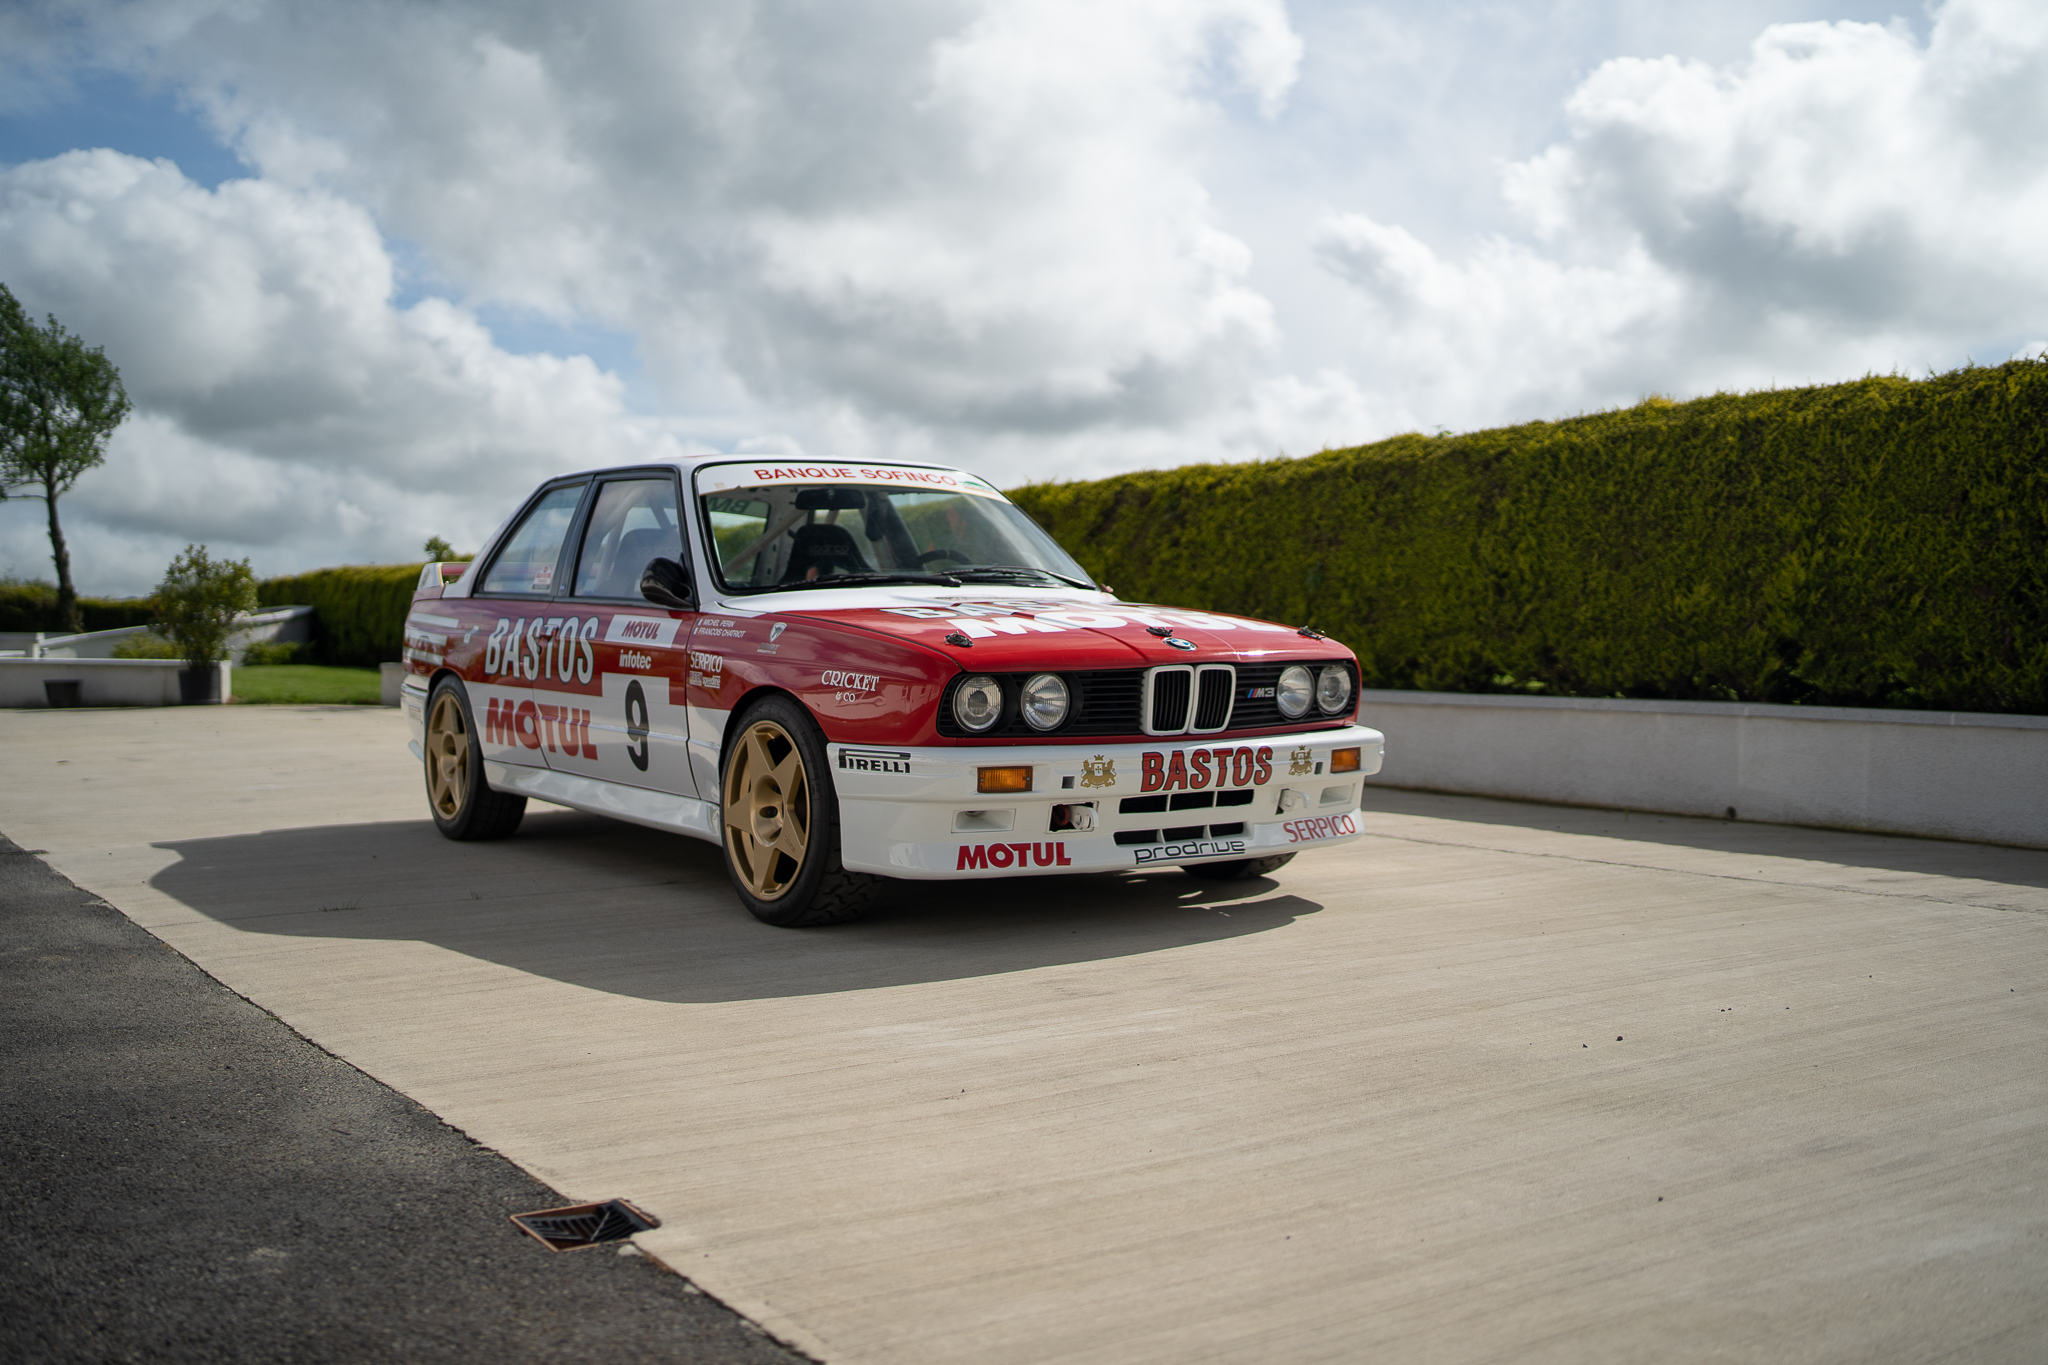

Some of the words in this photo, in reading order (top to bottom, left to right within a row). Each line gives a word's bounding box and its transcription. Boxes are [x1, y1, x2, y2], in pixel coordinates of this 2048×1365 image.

[753, 467, 856, 480] BANQUE
[859, 468, 957, 486] SOFINCO
[621, 620, 661, 640] MOTUL
[945, 611, 1290, 639] MOTUL
[484, 616, 600, 686] BASTOS
[619, 649, 652, 670] infotec
[690, 651, 723, 673] SERPICO
[821, 669, 880, 692] CRICKET
[1254, 687, 1275, 698] M3
[835, 691, 843, 701] &
[843, 692, 856, 702] CO
[485, 697, 599, 760] MOTUL
[624, 679, 650, 771] 9
[838, 748, 912, 773] PIRELLI
[1140, 745, 1274, 793] BASTOS
[1283, 814, 1357, 843] SERPICO
[956, 841, 1072, 871] MOTUL
[1133, 840, 1247, 865] prodrive
